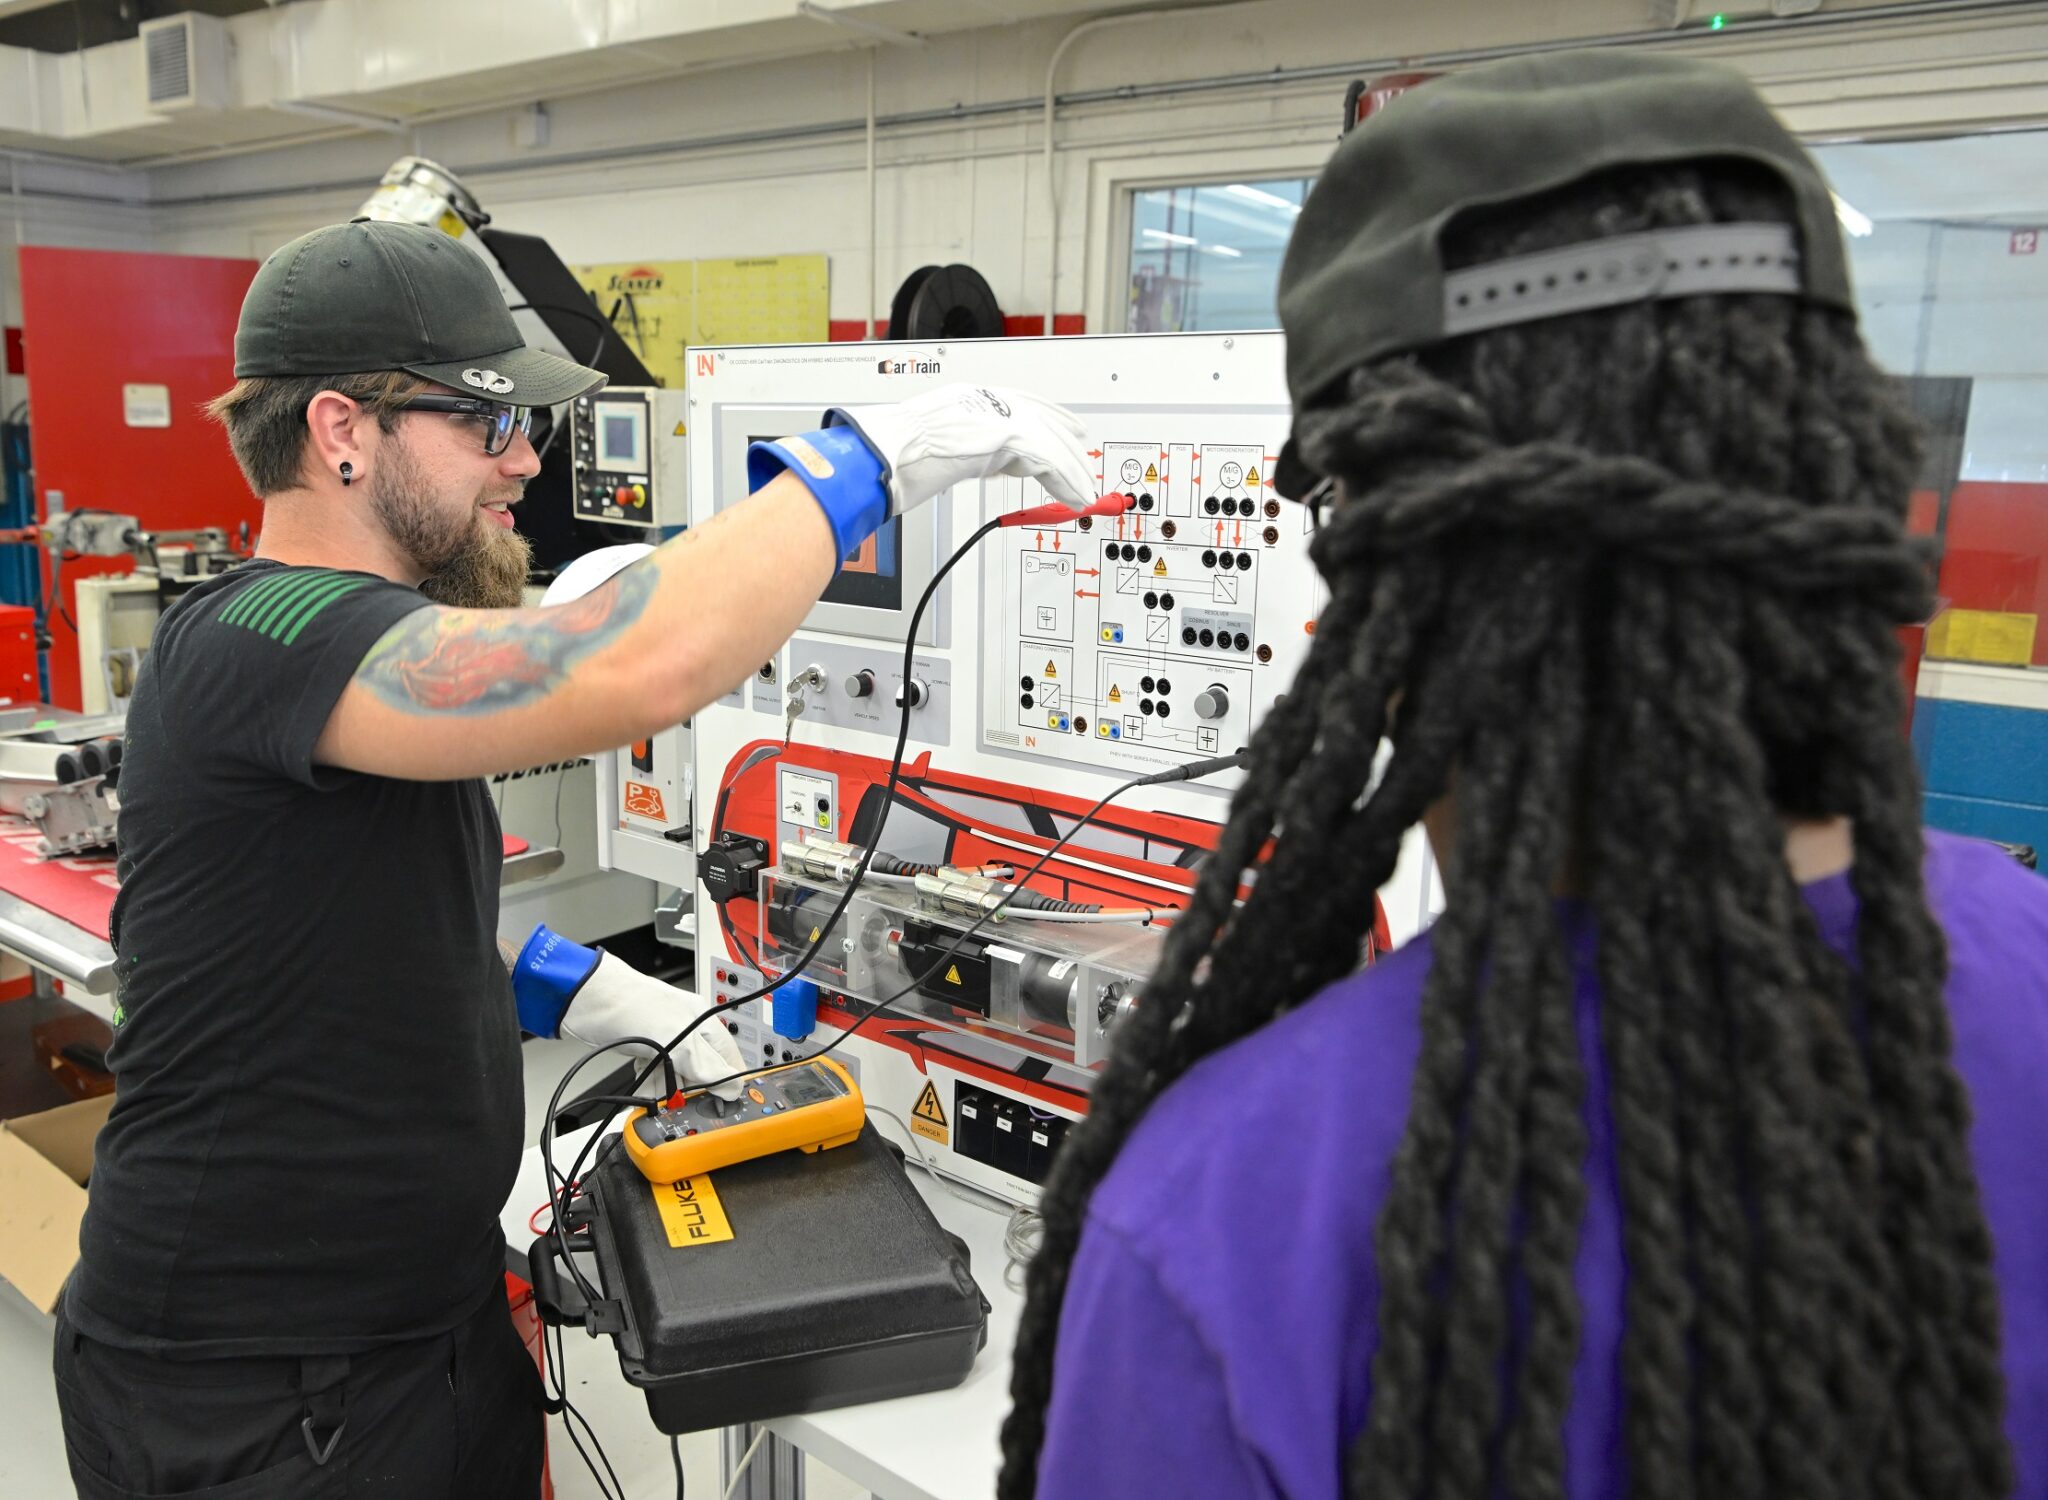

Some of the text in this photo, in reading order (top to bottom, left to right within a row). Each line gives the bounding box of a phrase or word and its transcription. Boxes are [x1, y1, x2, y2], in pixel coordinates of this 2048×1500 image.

[2015, 233, 2034, 252] 12
[1124, 462, 1139, 471] M/G
[1223, 466, 1239, 474] M/G
[1204, 609, 1229, 617] RESOLVER
[1188, 617, 1210, 625] COSINUS
[628, 783, 643, 798] P
[917, 1124, 941, 1138] DANGER
[672, 1179, 711, 1239] FLUKE
